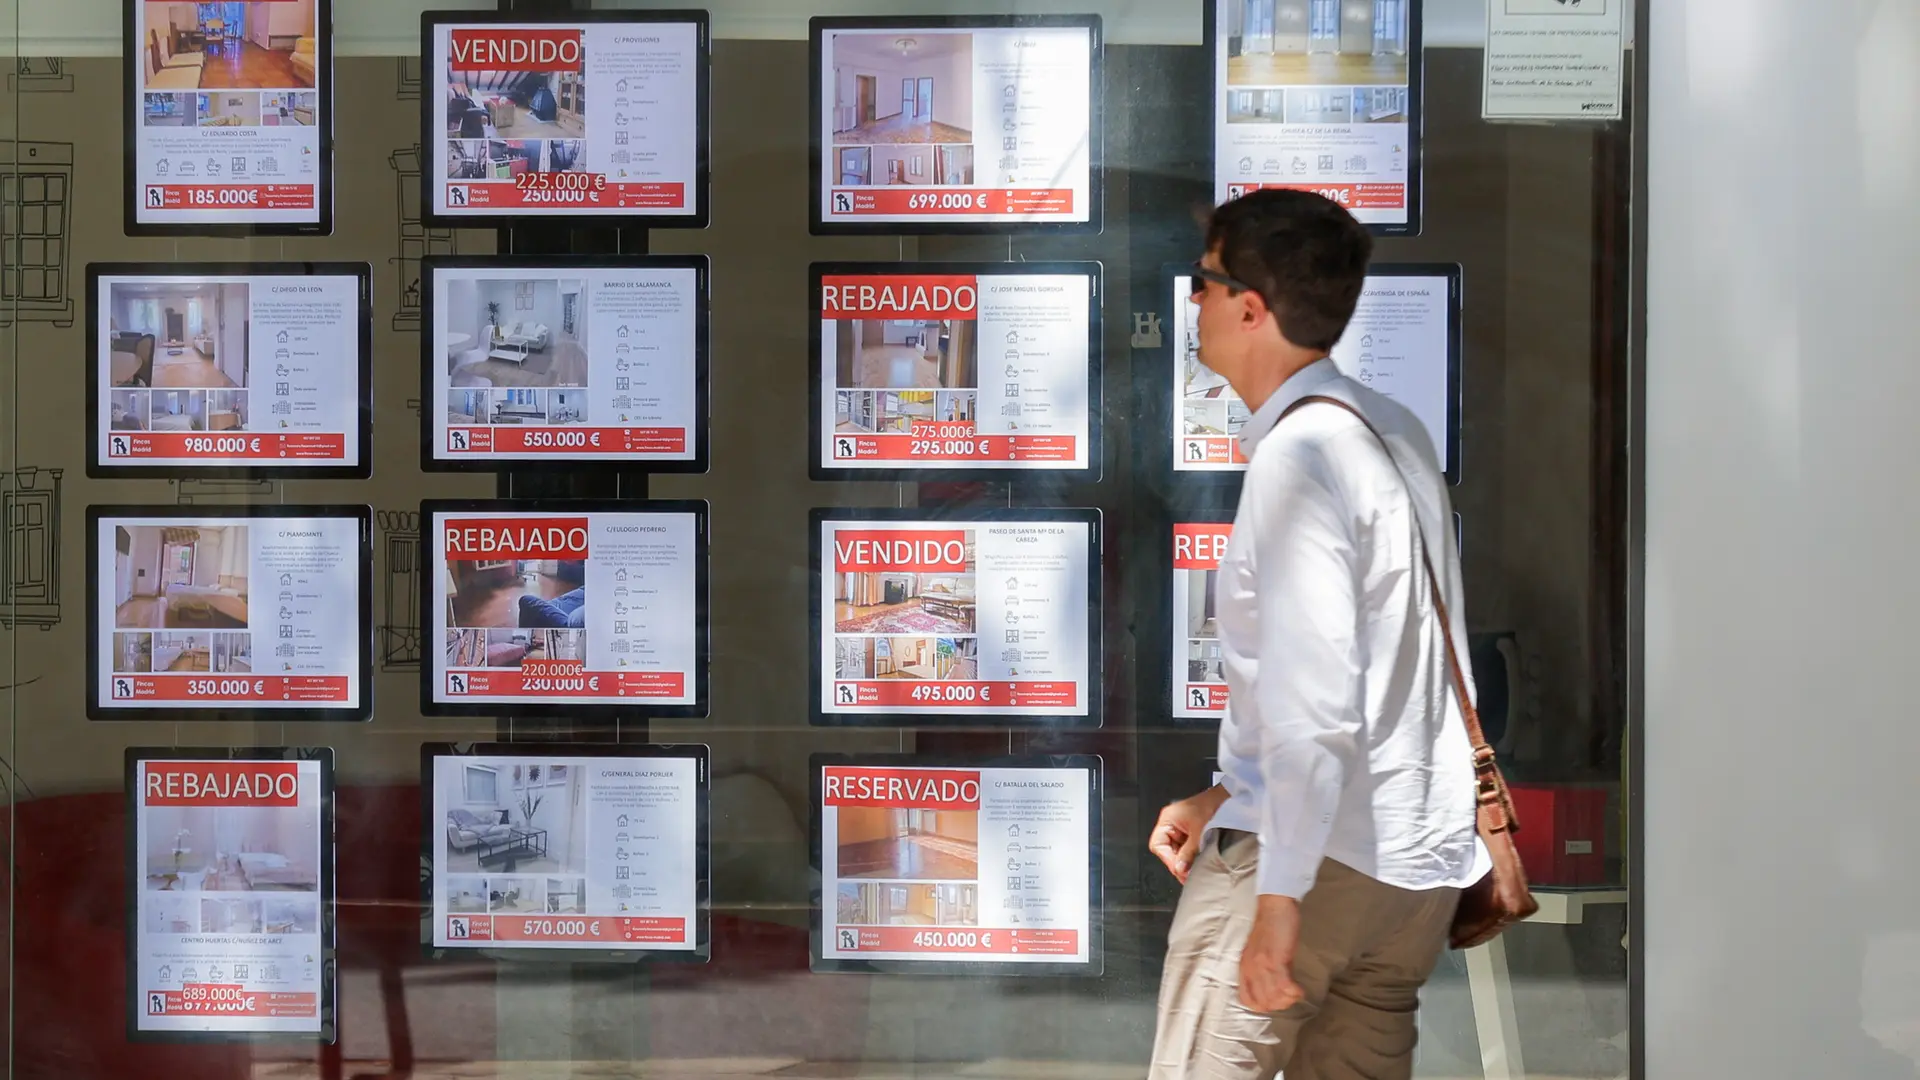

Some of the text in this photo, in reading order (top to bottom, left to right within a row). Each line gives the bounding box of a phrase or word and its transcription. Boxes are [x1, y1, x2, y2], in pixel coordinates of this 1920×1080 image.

[452, 39, 580, 64] VENDIDO
[516, 174, 590, 191] 225.000
[594, 174, 606, 191] €
[187, 190, 258, 204] 185.000€
[908, 194, 972, 209] 699.000
[976, 194, 987, 209] €
[822, 285, 976, 312] REBAJADO
[911, 425, 974, 438] 275.000€
[184, 438, 260, 453] 980.000 €
[523, 432, 600, 448] 550.000 €
[910, 440, 990, 456] 295.000 €
[446, 528, 588, 552] REBAJADO
[1175, 534, 1229, 560] REB
[835, 540, 965, 564] VENDIDO
[522, 664, 583, 677] 220.000€
[188, 680, 264, 695] 350.000 €
[522, 676, 600, 692] 230.000 €
[911, 686, 990, 701] 495.000 €
[147, 772, 297, 798] REBAJADO
[825, 776, 980, 802] RESERVADO
[523, 920, 600, 936] 570.000 €
[913, 932, 992, 948] 450.000 €
[182, 988, 243, 1000] 689.000€
